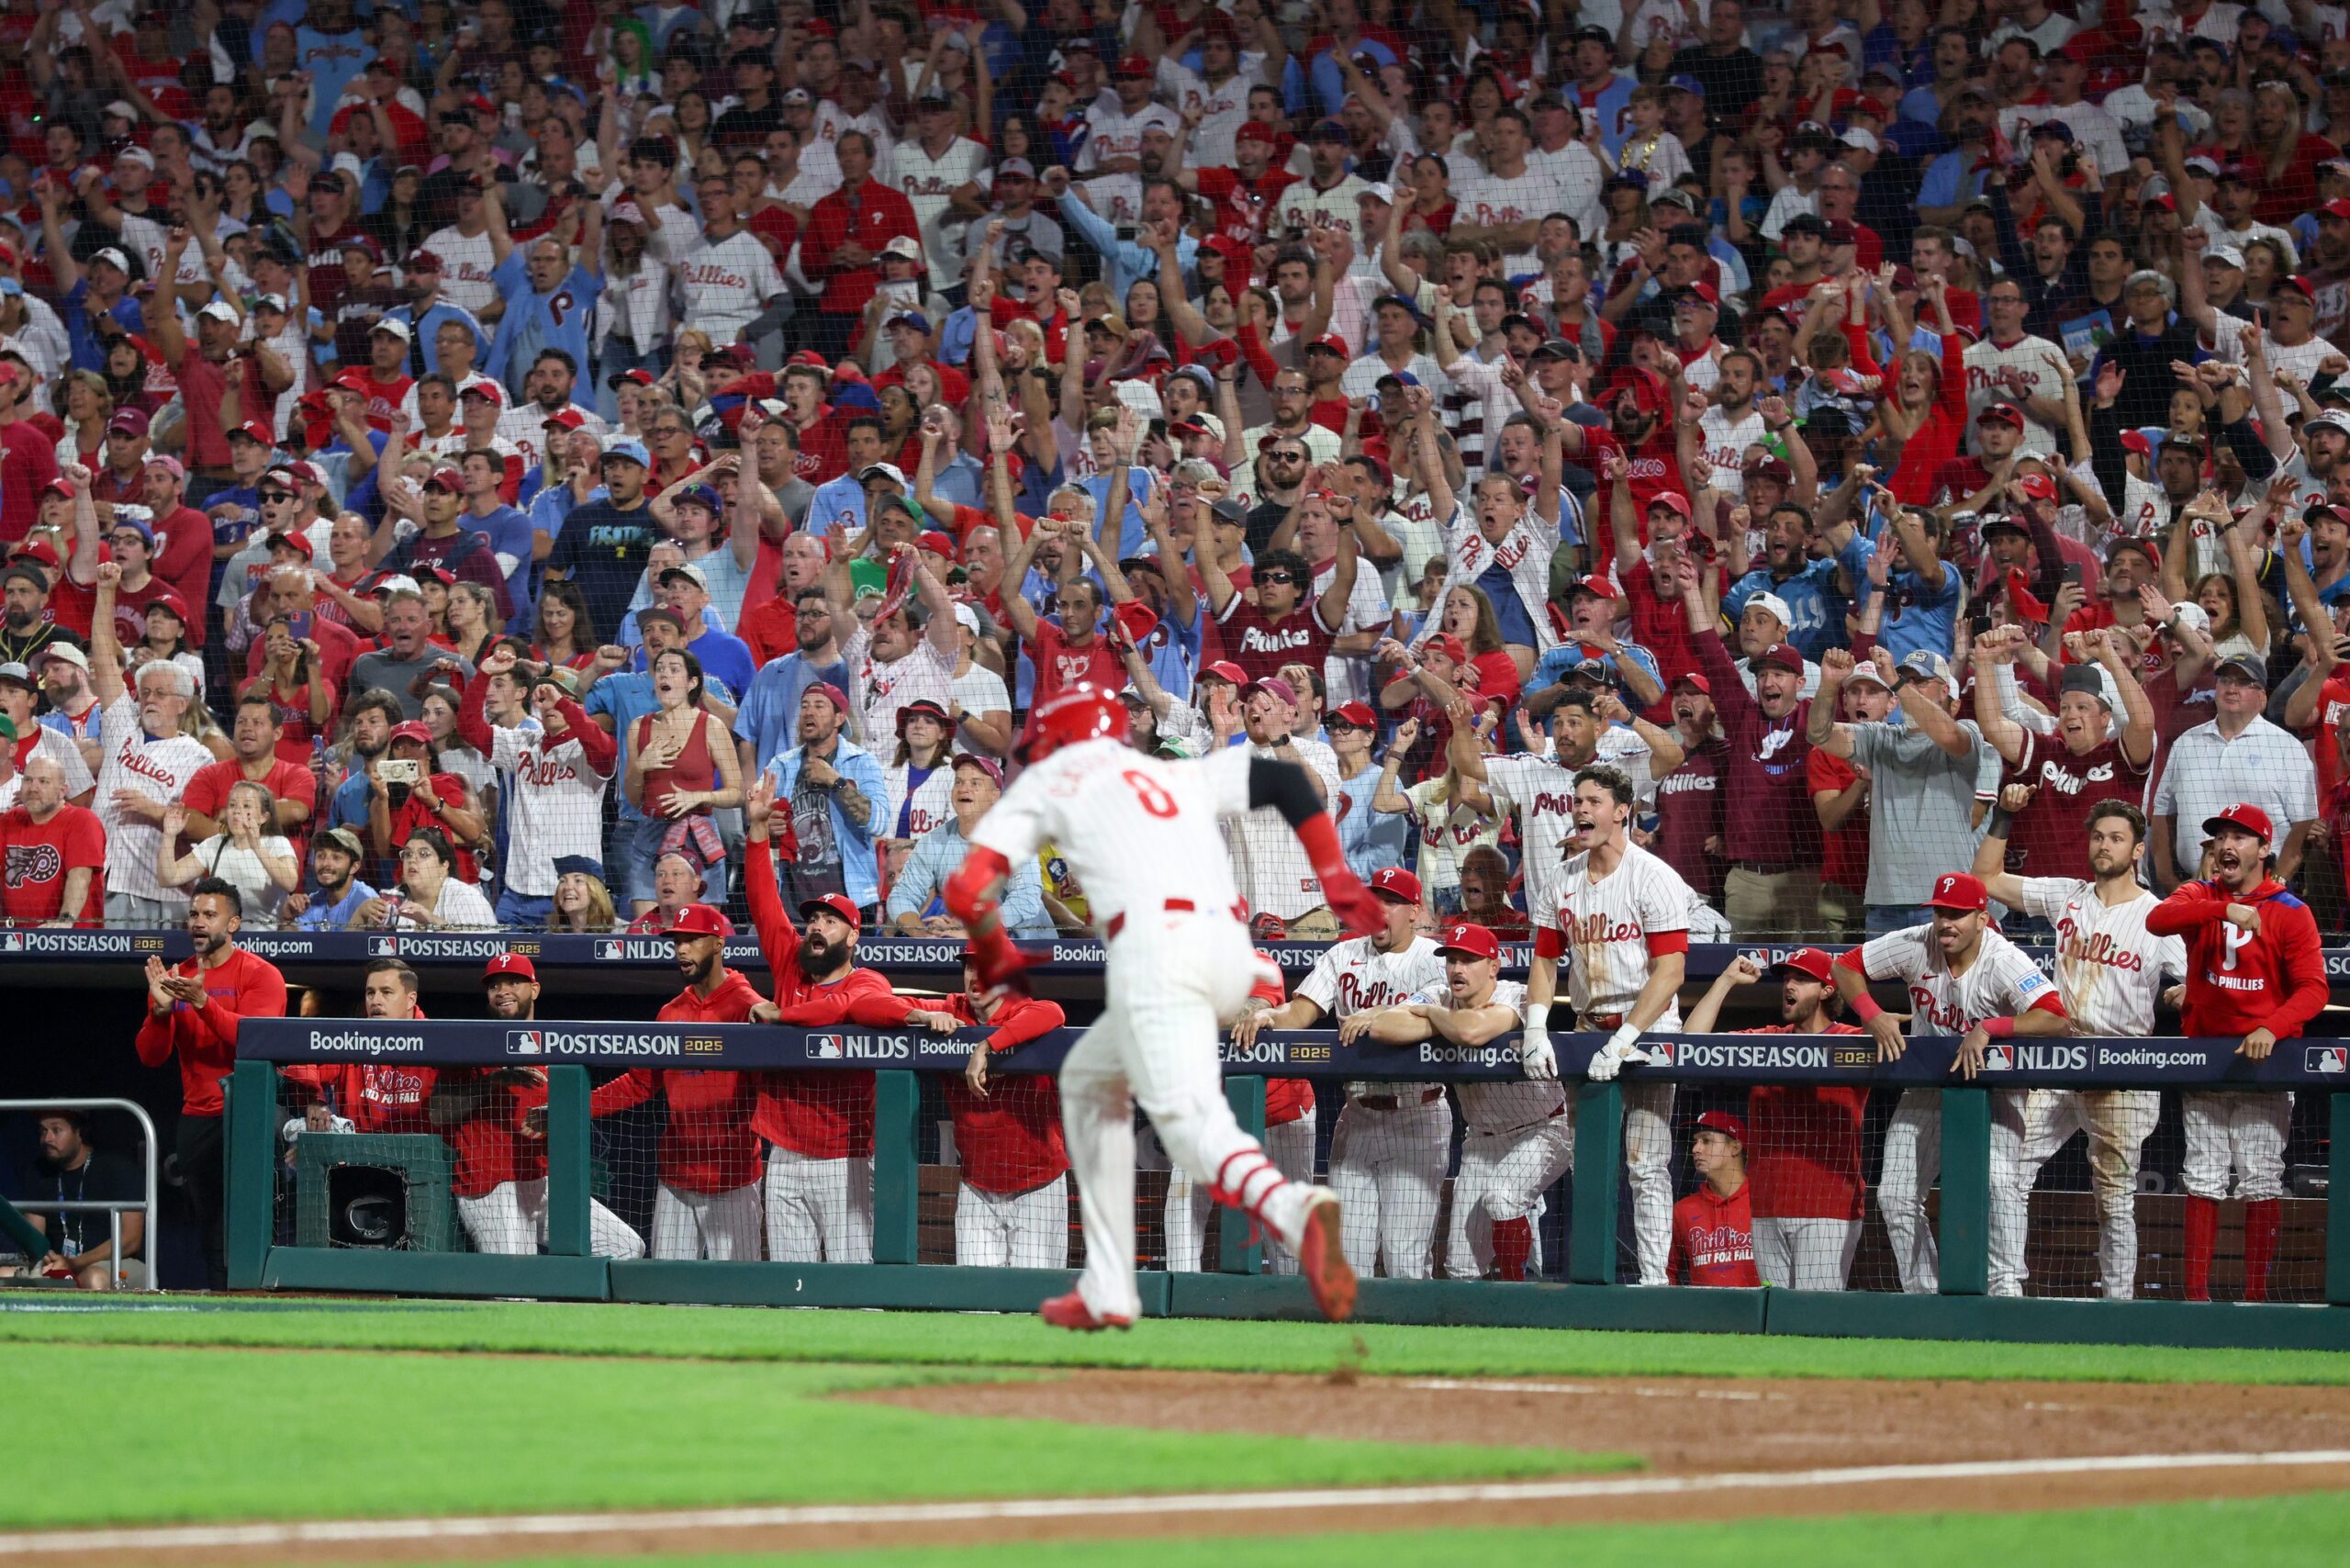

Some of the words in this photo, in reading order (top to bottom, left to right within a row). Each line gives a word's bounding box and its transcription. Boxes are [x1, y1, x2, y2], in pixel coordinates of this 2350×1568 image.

[550, 292, 574, 327] P
[1238, 626, 1310, 653] Phillies
[1123, 769, 1180, 820] 8
[2229, 804, 2241, 816] P
[1383, 870, 1395, 883] P
[1943, 878, 1955, 892] P
[679, 908, 689, 923] P
[1457, 927, 1467, 941] P
[1559, 909, 1642, 945] Phillies
[26, 933, 130, 952] POSTSEASON
[135, 941, 163, 950] 2025
[232, 936, 313, 957] ooking.com
[400, 939, 506, 957] POSTSEASON
[509, 945, 542, 955] 2025
[627, 941, 677, 959] NLDS
[2057, 918, 2143, 971] Phillies
[499, 955, 510, 968] P
[855, 945, 959, 963] POSTSEASON
[1795, 949, 1807, 960] P
[2018, 974, 2045, 992] IBX
[2219, 975, 2265, 991] PHILLIES
[310, 1031, 423, 1055] Booking.com
[545, 1033, 680, 1055] POSTSEASON
[685, 1041, 723, 1052] 2025
[846, 1036, 910, 1059] NLDS
[1290, 1047, 1331, 1058] 2025
[1420, 1043, 1523, 1067] Booking.co
[1677, 1044, 1828, 1068] POSTSEASON
[1834, 1052, 1876, 1063] 2025
[2017, 1047, 2087, 1070] NLDS
[2099, 1048, 2207, 1069] Booking.com
[1714, 1249, 1732, 1263] FOR
